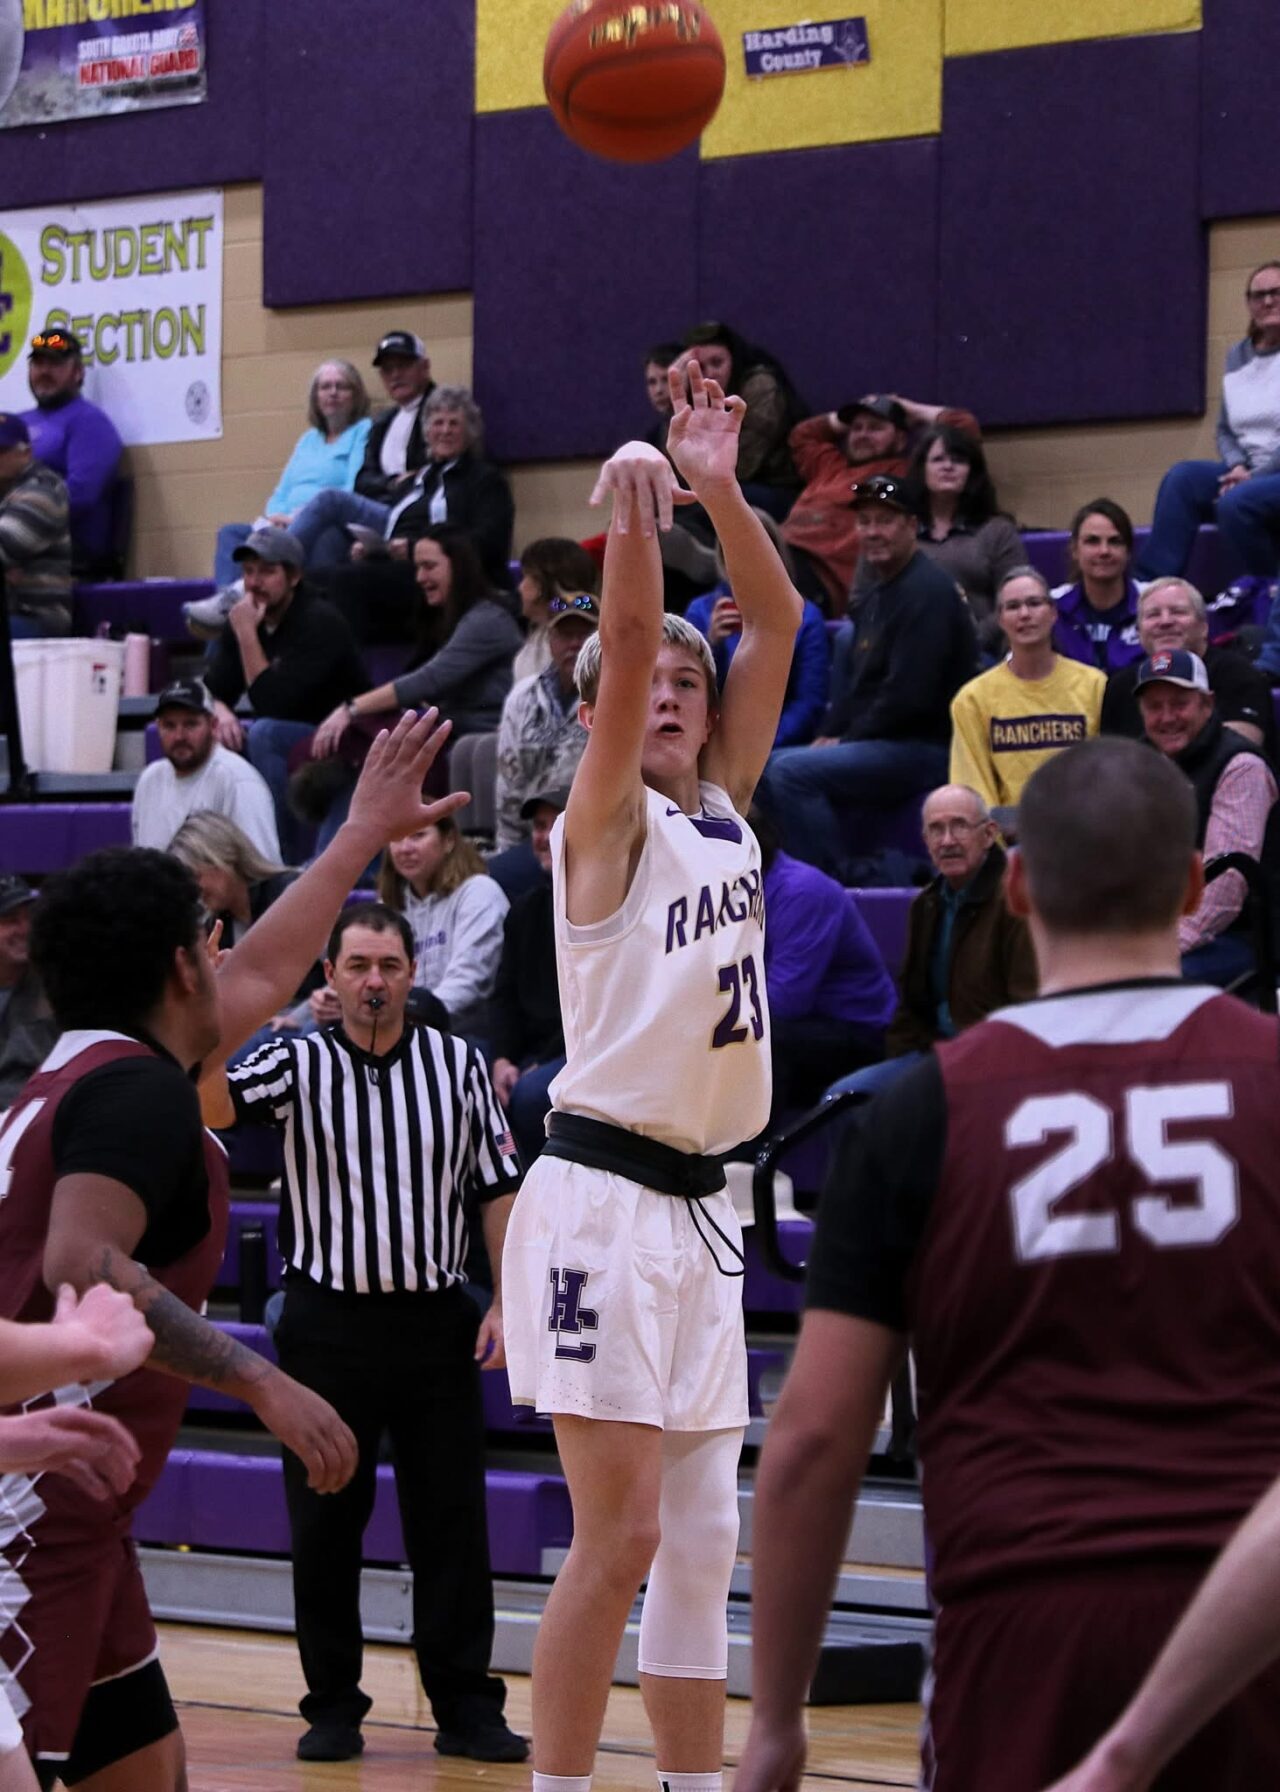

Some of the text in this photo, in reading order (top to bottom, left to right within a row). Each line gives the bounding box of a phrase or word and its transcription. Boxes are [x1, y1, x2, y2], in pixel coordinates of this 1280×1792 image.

[745, 25, 834, 51] Harding
[80, 48, 198, 85] NATIONAL GUARD
[760, 49, 822, 72] County
[40, 215, 214, 286] STUDENT
[993, 720, 1083, 744] RANCHERS
[712, 954, 764, 1049] 23
[1003, 1080, 1241, 1266] 25
